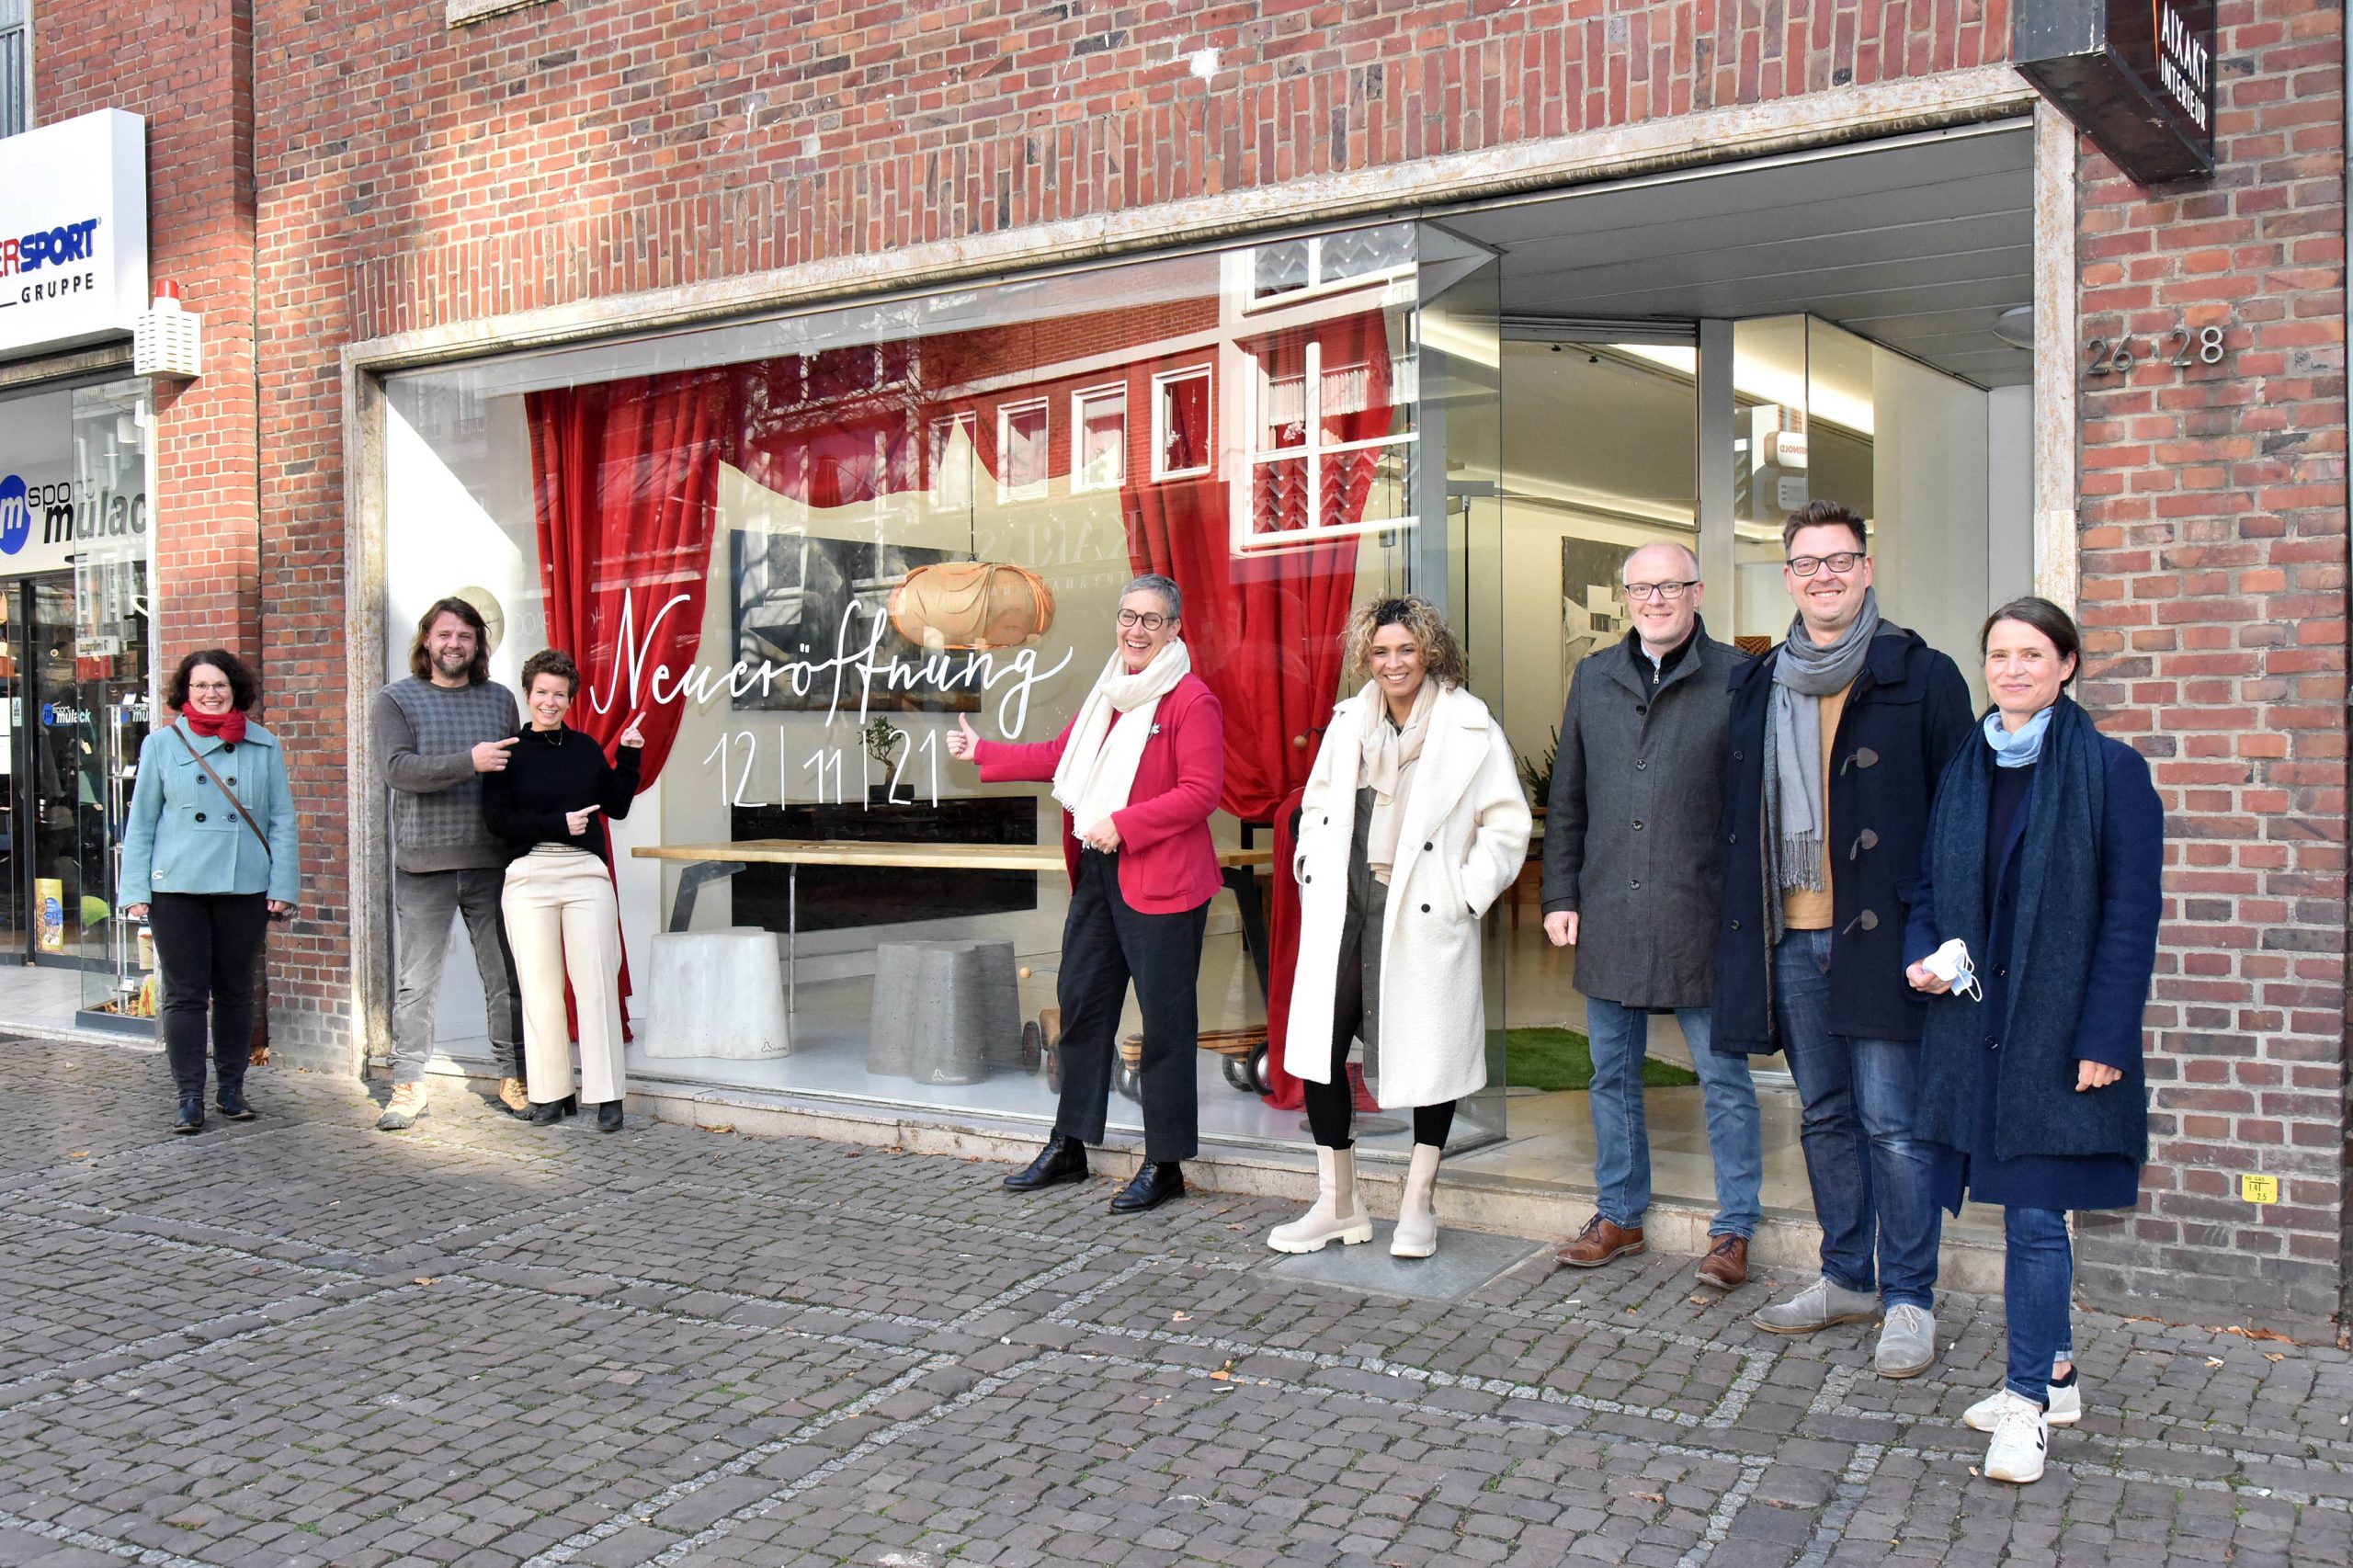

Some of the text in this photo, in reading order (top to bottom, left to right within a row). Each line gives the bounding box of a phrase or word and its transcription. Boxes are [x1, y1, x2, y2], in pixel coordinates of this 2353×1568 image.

[2161, 2, 2208, 93] AIXAKT
[2161, 53, 2206, 131] INTERIEUR
[21, 273, 94, 303] GRUPPE
[2086, 325, 2224, 376] 26 28
[590, 587, 1074, 739] Neueröffnung
